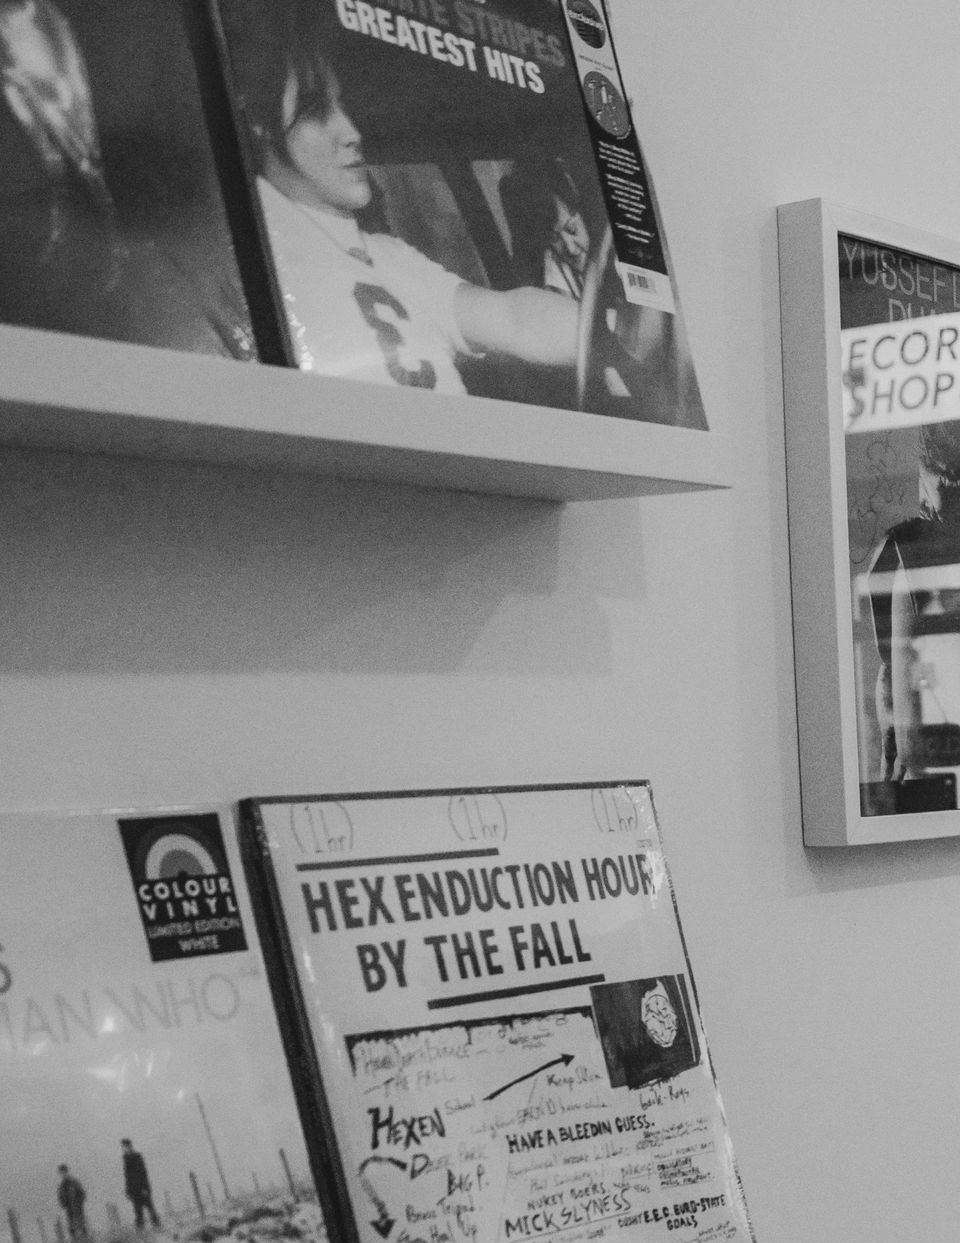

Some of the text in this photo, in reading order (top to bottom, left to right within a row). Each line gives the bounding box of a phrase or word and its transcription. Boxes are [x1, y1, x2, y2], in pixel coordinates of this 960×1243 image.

[336, 0, 546, 94] GREATEST HITS
[842, 240, 946, 302] YUSSEF
[848, 372, 955, 418] SHOP
[138, 876, 232, 902] COLOUR
[142, 896, 238, 920] VINYL
[301, 852, 657, 934] HEX ENDUCTION HOUR
[149, 916, 242, 939] LIMITED EDITION
[178, 934, 221, 953] WHITE
[355, 918, 592, 993] BY THE FALL
[367, 1104, 446, 1150] HEXEN
[506, 1129, 545, 1154] HAVE
[547, 1128, 558, 1146] A
[559, 1120, 613, 1142] BLEEDIN
[504, 1209, 561, 1239] MICK
[560, 1188, 631, 1226] SLYNESS
[666, 1215, 699, 1231] GOALS
